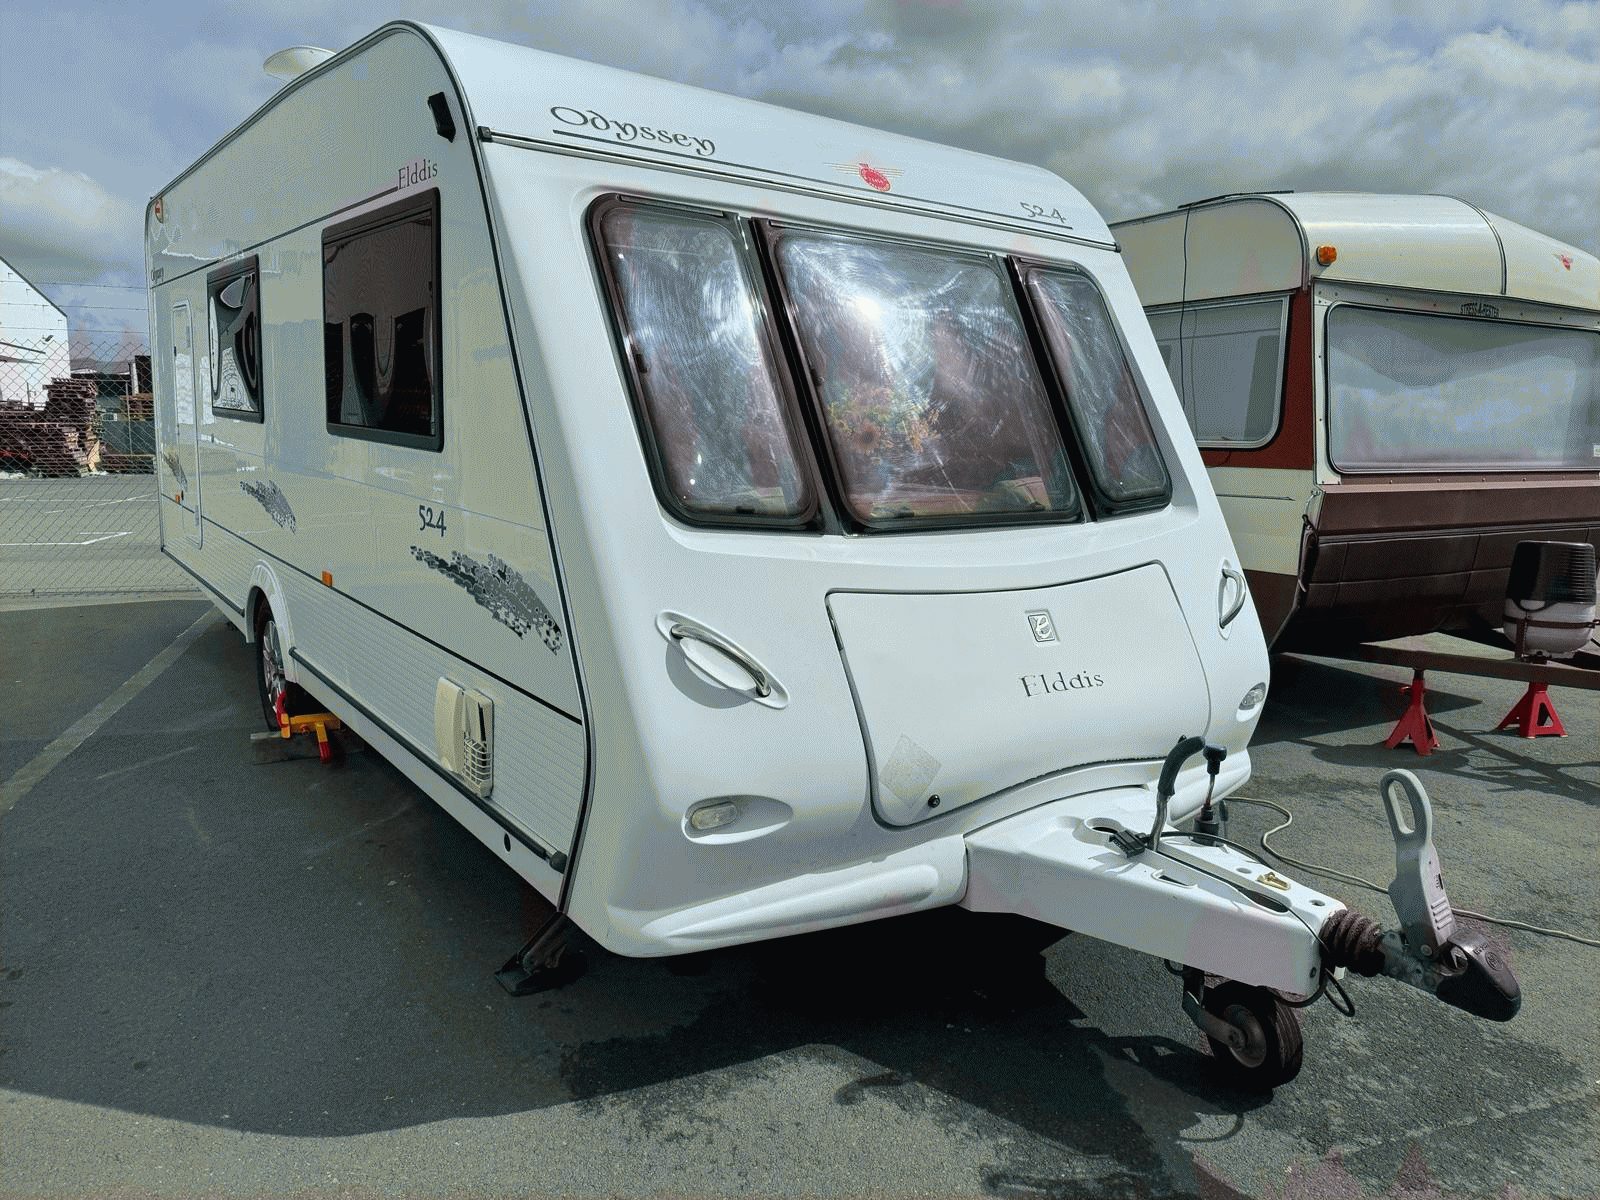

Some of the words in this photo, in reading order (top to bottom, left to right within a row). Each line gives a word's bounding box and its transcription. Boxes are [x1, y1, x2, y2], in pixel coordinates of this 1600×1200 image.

[550, 106, 716, 157] Odyssey
[398, 158, 438, 190] Elddis
[1019, 201, 1067, 224] 524
[419, 504, 447, 537] 524
[1020, 670, 1104, 697] Elddis
